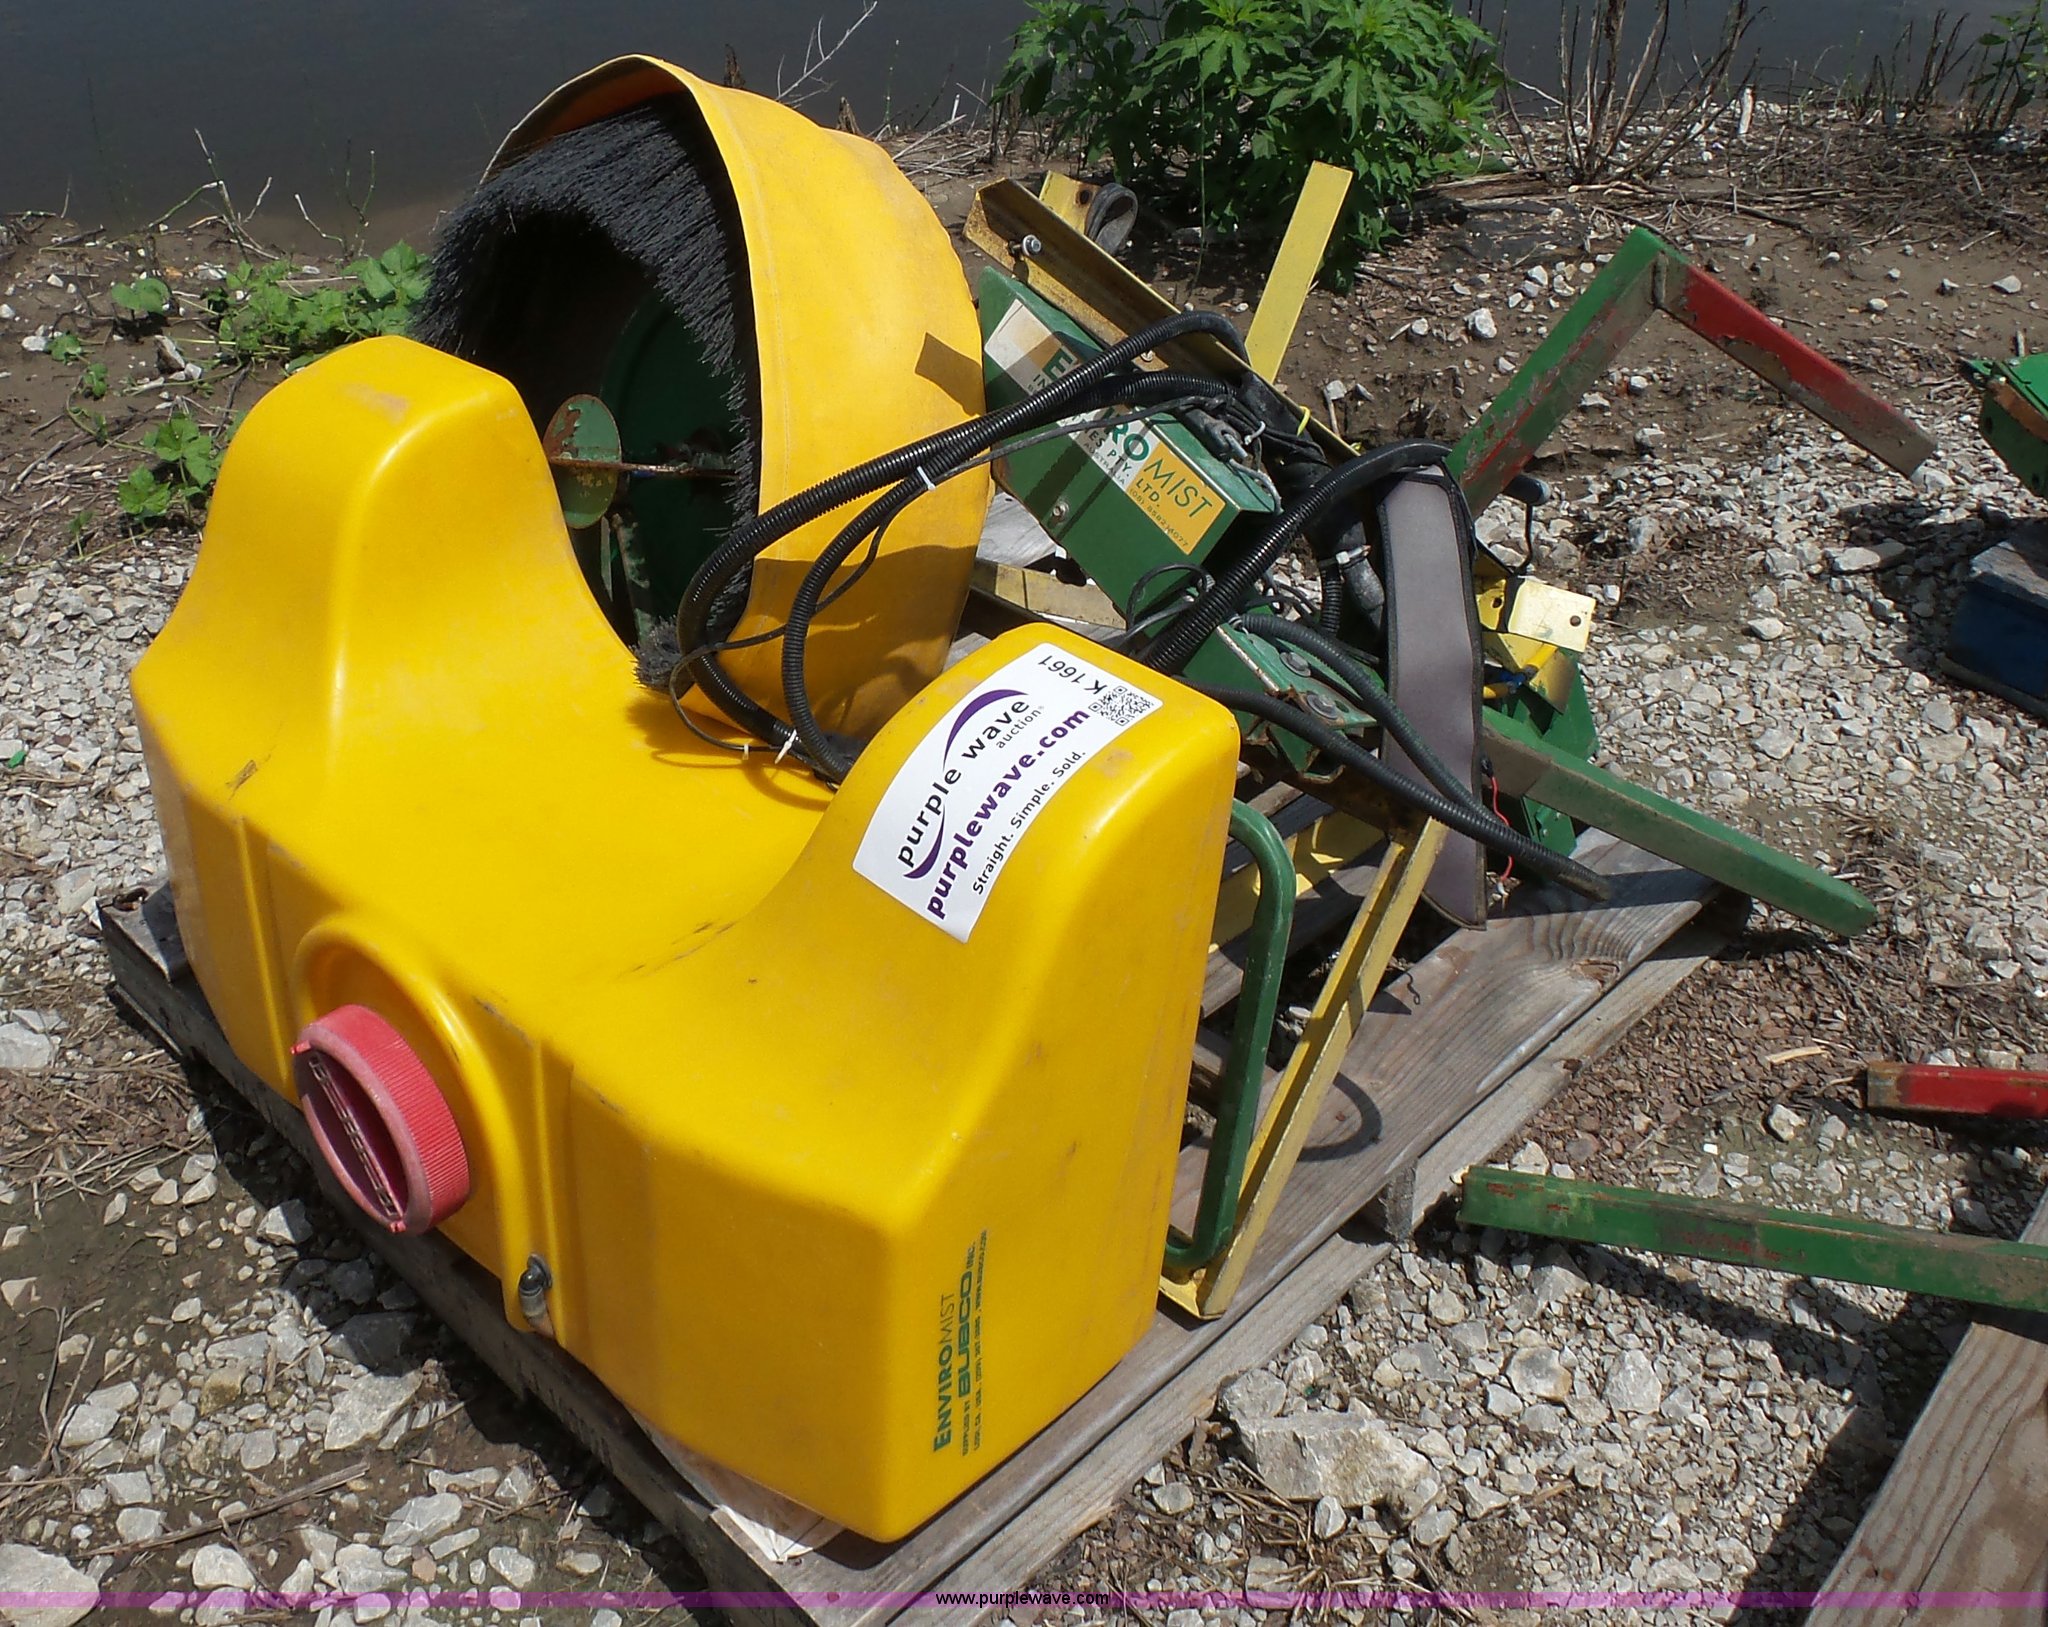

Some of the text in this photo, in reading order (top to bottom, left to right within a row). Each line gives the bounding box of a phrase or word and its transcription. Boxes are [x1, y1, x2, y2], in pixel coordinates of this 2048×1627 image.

[1107, 449, 1160, 508] PTY. LTD.
[996, 709, 1041, 749] auction
[1037, 655, 1108, 695] K 1661
[897, 700, 1030, 868] purple wave
[927, 709, 1090, 920] purplewave.com
[972, 751, 1086, 895] Straight. Simple. Sold.
[958, 1270, 972, 1398] BUBCO
